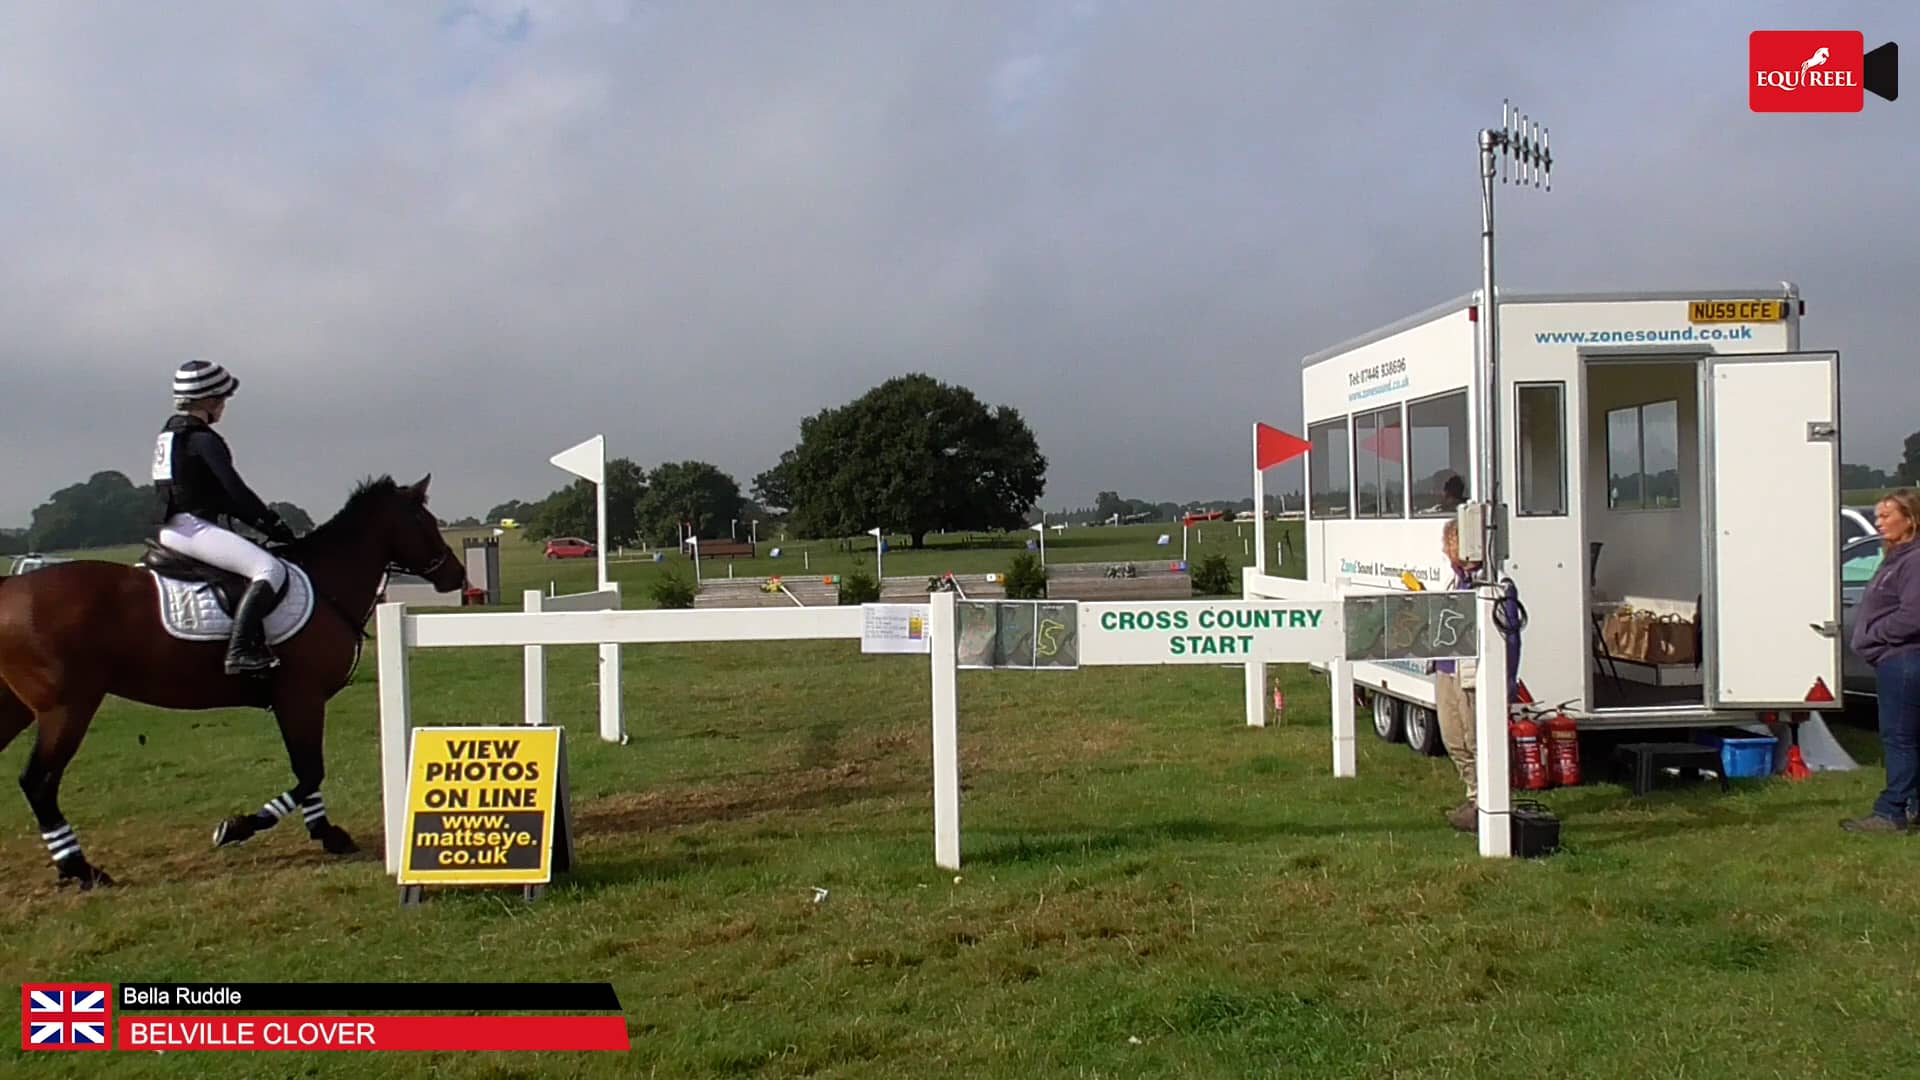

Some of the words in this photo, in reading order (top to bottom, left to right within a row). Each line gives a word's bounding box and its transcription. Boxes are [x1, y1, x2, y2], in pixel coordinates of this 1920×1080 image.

[1695, 302, 1736, 319] NU59
[1740, 302, 1772, 318] CFE
[1535, 325, 1752, 344] www.zonesound.co.uk
[1100, 611, 1189, 630] CROSS
[1199, 609, 1323, 629] COUNTRY
[1170, 635, 1253, 654] START
[446, 741, 520, 759] VIEW
[426, 762, 539, 781] PHOTOS
[424, 788, 470, 809] ON
[478, 788, 538, 808] LINE
[442, 815, 511, 830] www.
[416, 829, 539, 850] mattseye.
[438, 847, 508, 865] co.uk
